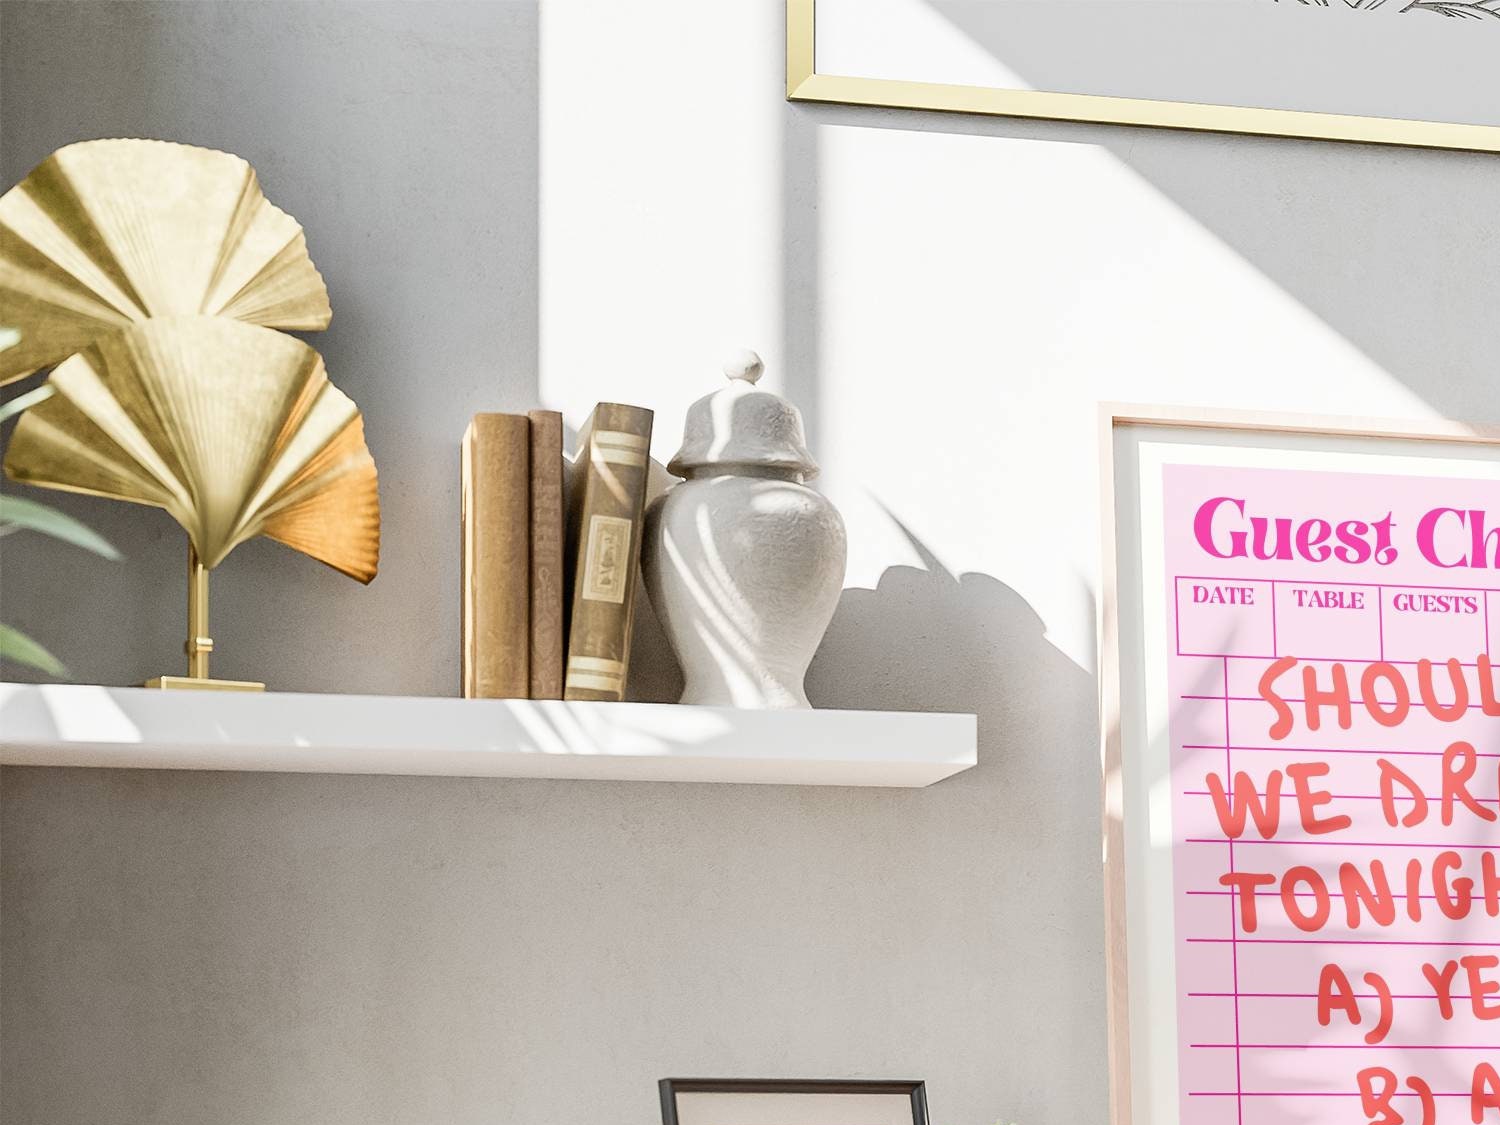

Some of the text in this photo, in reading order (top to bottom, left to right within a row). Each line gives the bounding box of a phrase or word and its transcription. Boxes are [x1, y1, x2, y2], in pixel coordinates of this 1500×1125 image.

[1193, 496, 1399, 566] Guest
[1192, 585, 1254, 605] DATE
[1293, 589, 1365, 610] TABLE
[1393, 592, 1478, 614] GUESTS
[1205, 762, 1352, 839] WE
[1317, 963, 1393, 1045] A)
